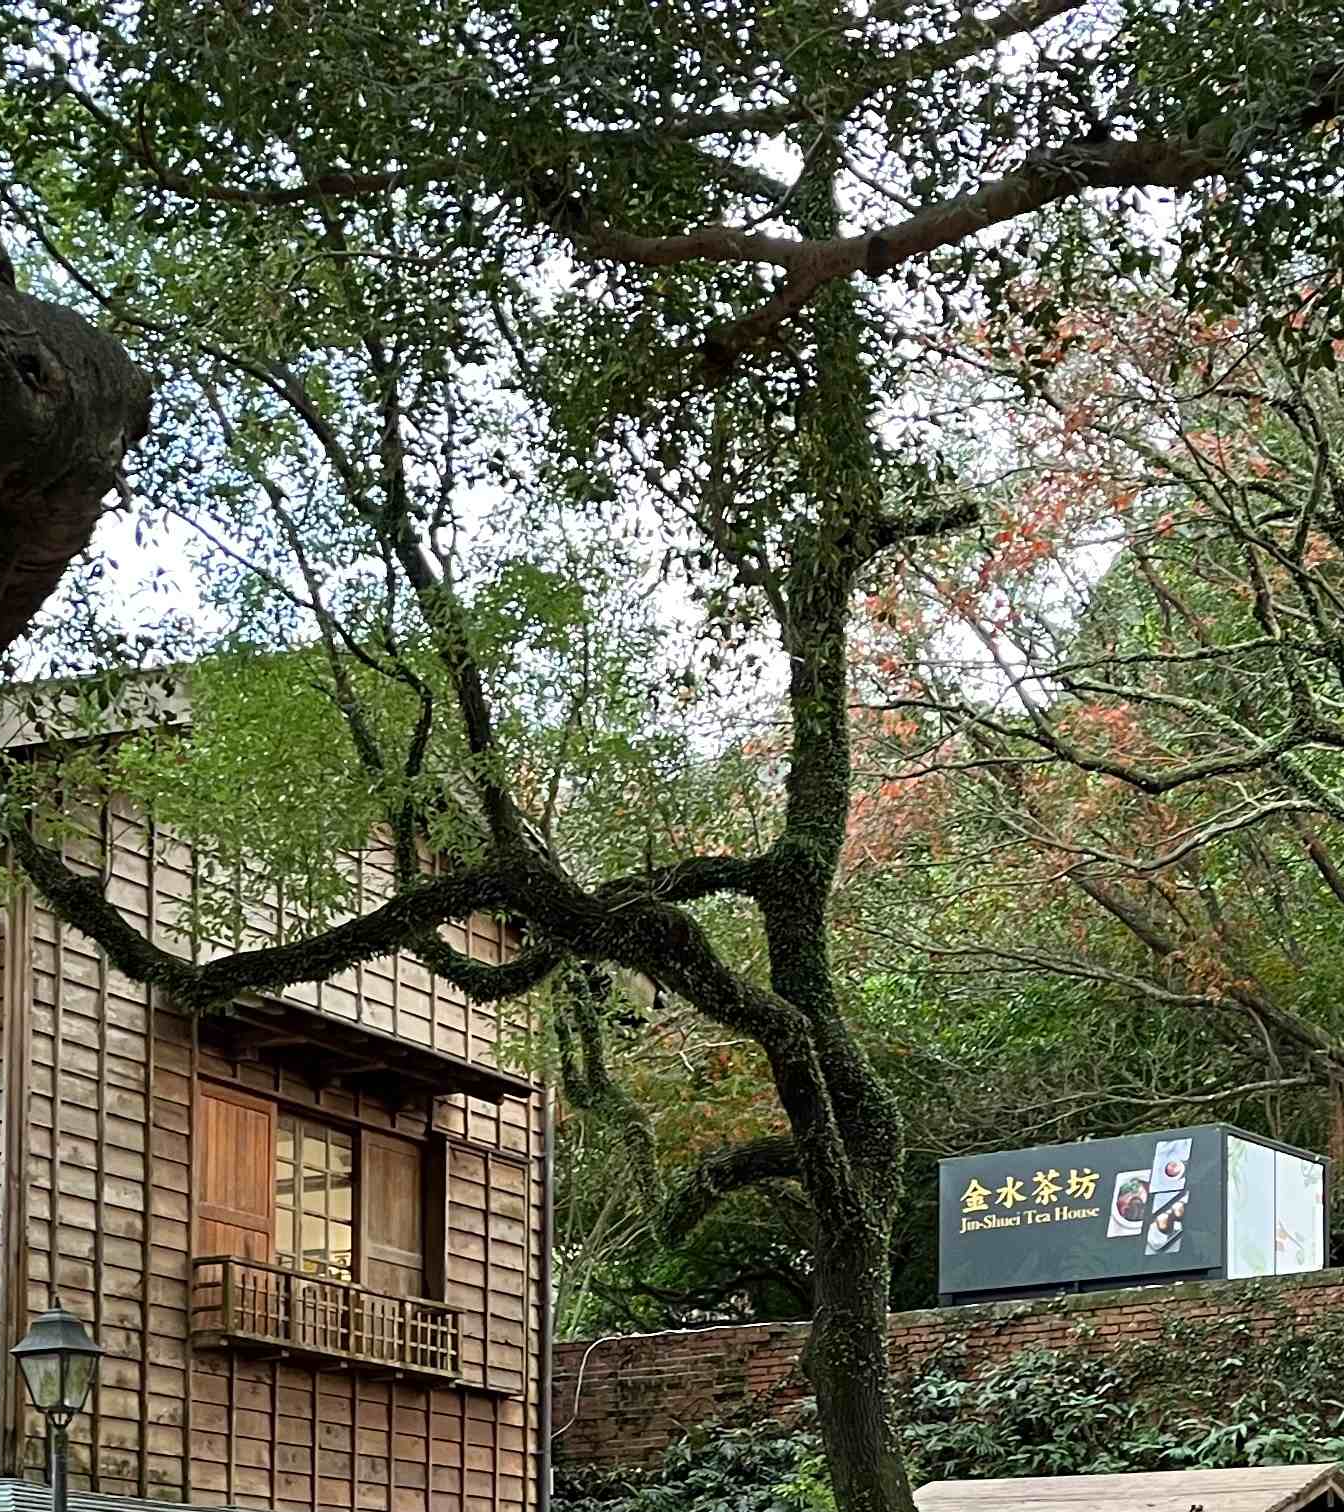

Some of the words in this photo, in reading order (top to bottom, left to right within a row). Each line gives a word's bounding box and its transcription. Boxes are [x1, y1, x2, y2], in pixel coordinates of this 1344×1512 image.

[959, 1168, 1100, 1213] 金水茶坊
[959, 1212, 1021, 1234] Jin-Shuei
[1023, 1209, 1051, 1225] Tea
[1055, 1206, 1100, 1221] House
